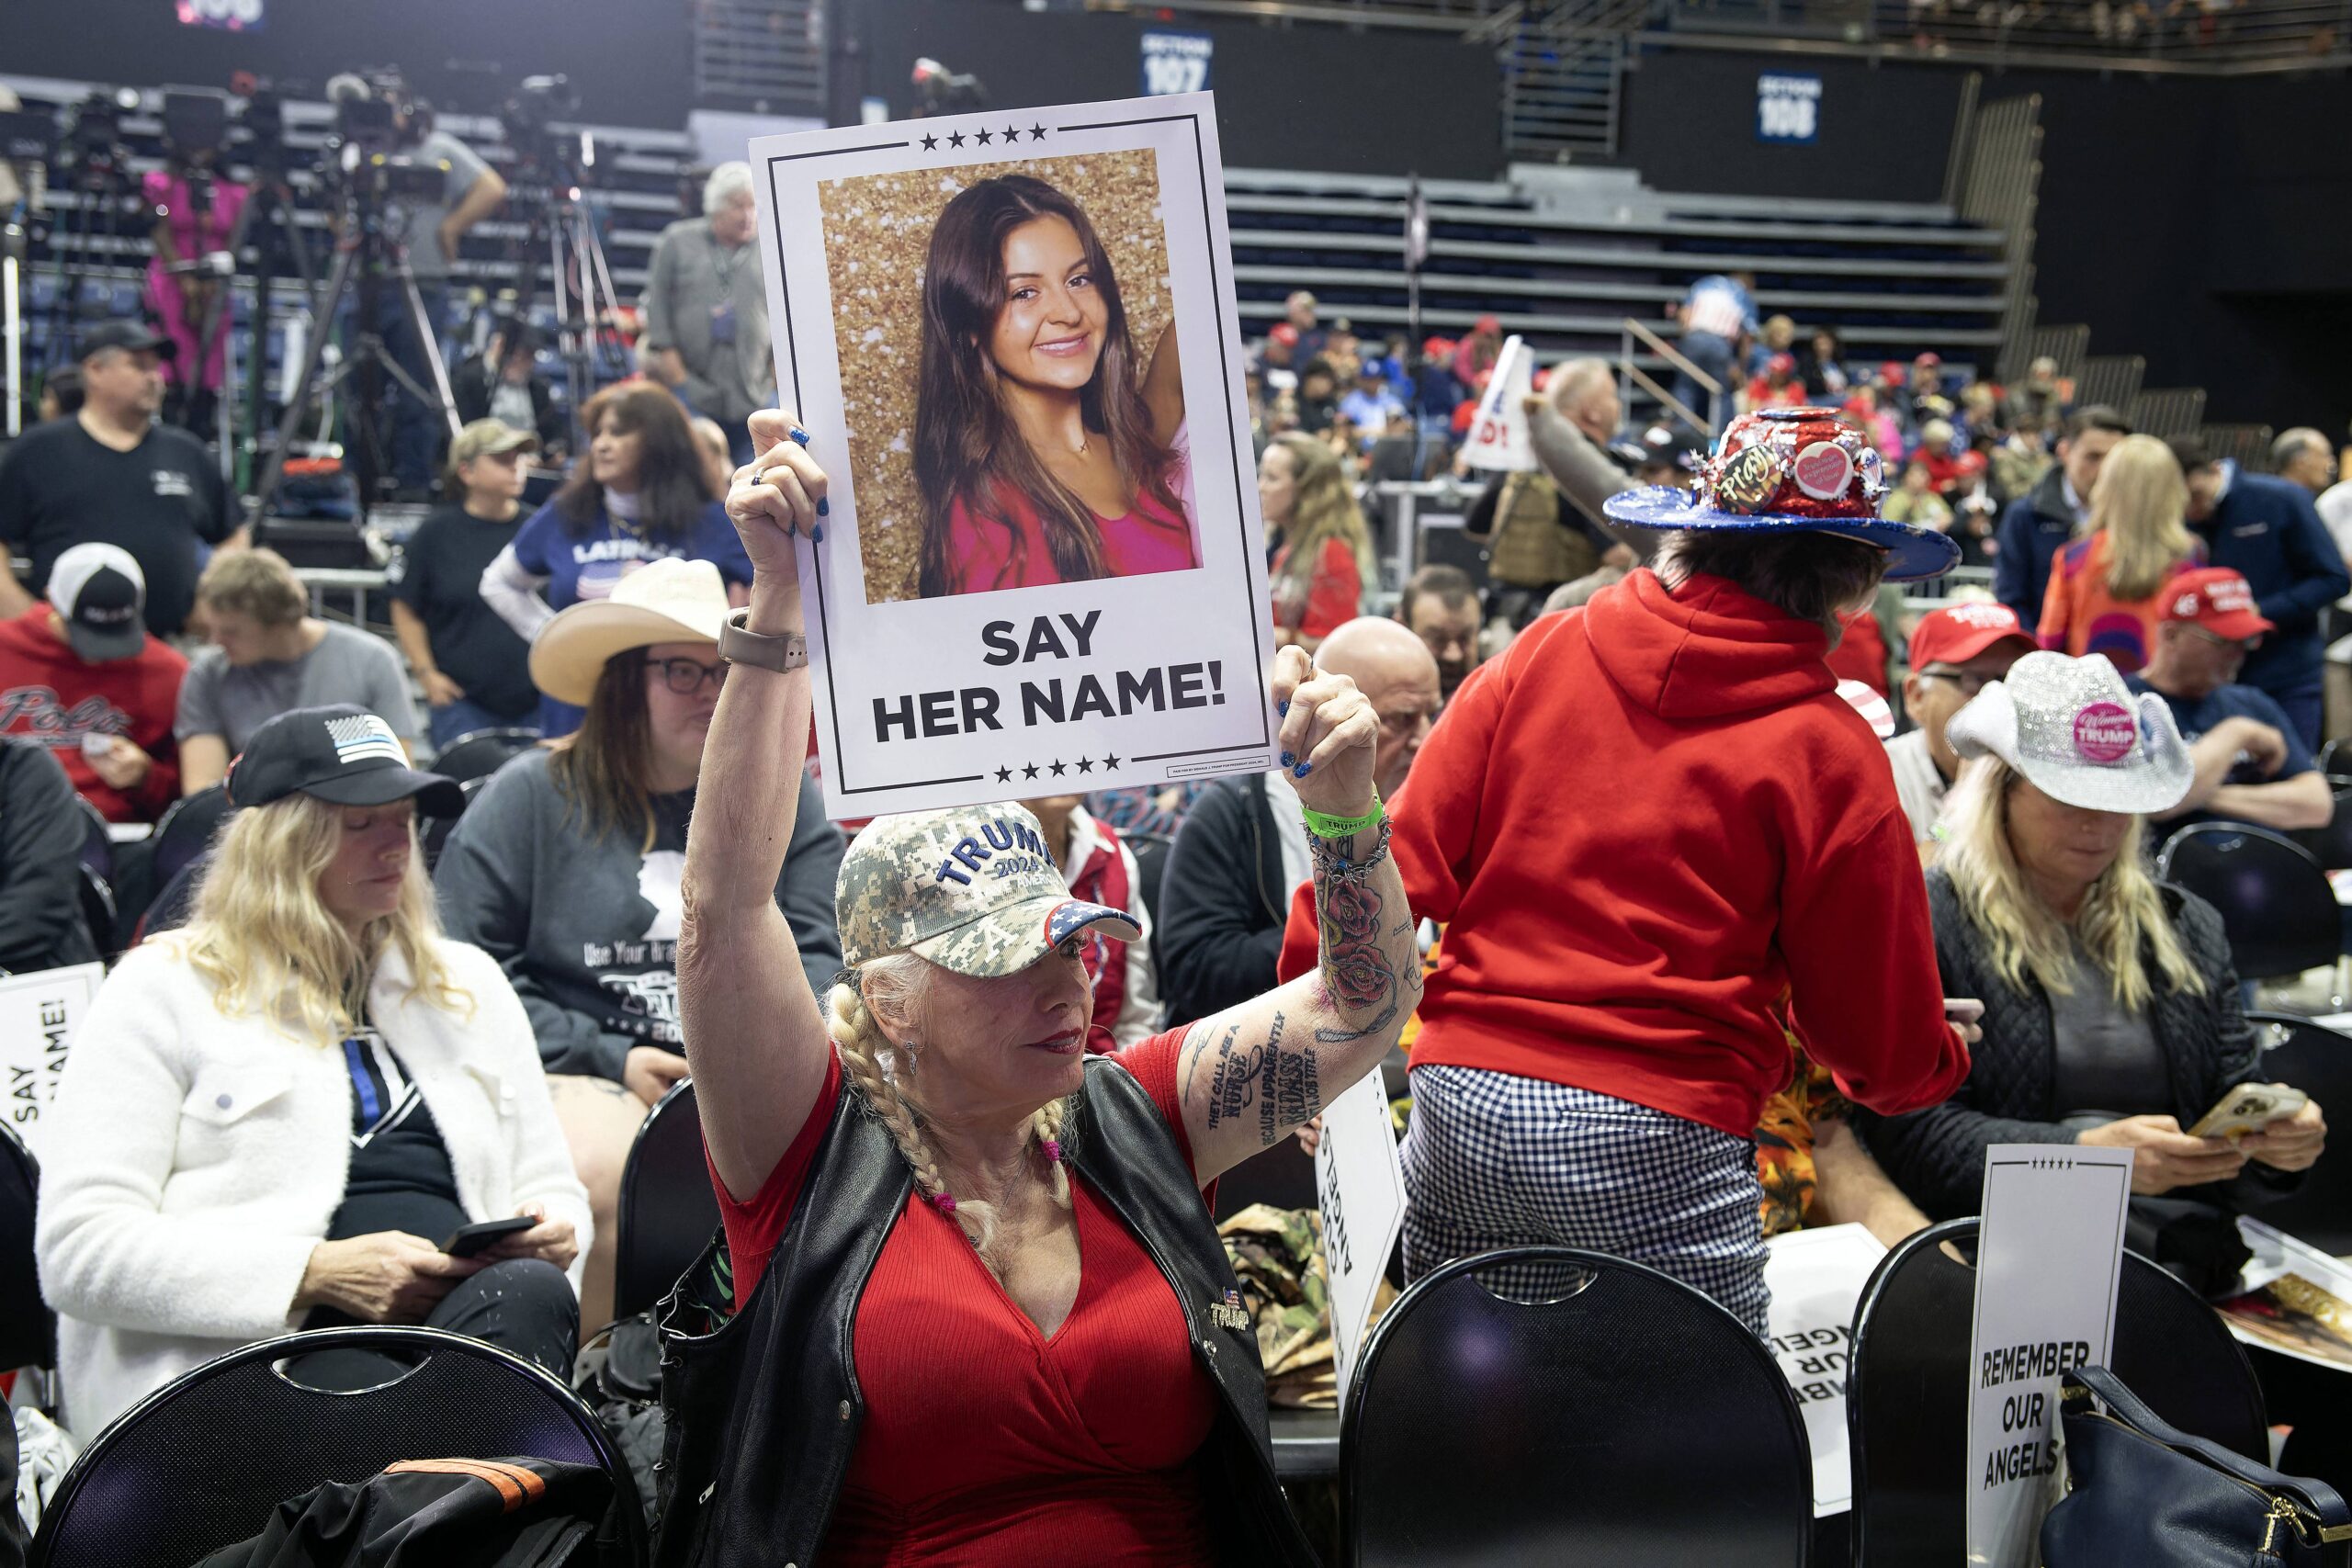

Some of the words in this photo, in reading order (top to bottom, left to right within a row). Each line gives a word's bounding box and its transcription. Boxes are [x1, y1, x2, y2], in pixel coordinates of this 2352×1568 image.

[1145, 55, 1206, 95] 107
[981, 610, 1102, 667] SAY
[872, 686, 1004, 743] HER
[1020, 660, 1226, 727] NAME!
[2076, 727, 2134, 745] TRUMP
[1326, 820, 1366, 831] TRUMP
[994, 855, 1040, 879] 2024
[583, 942, 612, 967] Use
[614, 940, 647, 964] Your
[1218, 1033, 1234, 1058] ME
[1229, 1024, 1240, 1035] A
[1261, 1010, 1285, 1100] APPARENTLY
[1304, 1046, 1318, 1079] TITLE
[10, 1066, 40, 1122] SAY
[1212, 1062, 1227, 1097] CALL
[1222, 1052, 1248, 1119] NURSE
[1277, 1051, 1308, 1127] BADASS
[1208, 1101, 1222, 1131] THEY
[1260, 1102, 1277, 1146] BECAUSE
[1211, 1303, 1250, 1331] TRUMP
[1793, 1352, 1849, 1374] UR
[1981, 1341, 2090, 1389] REMEMBER
[2002, 1393, 2044, 1433] OUR
[1984, 1439, 2059, 1491] ANGELS
